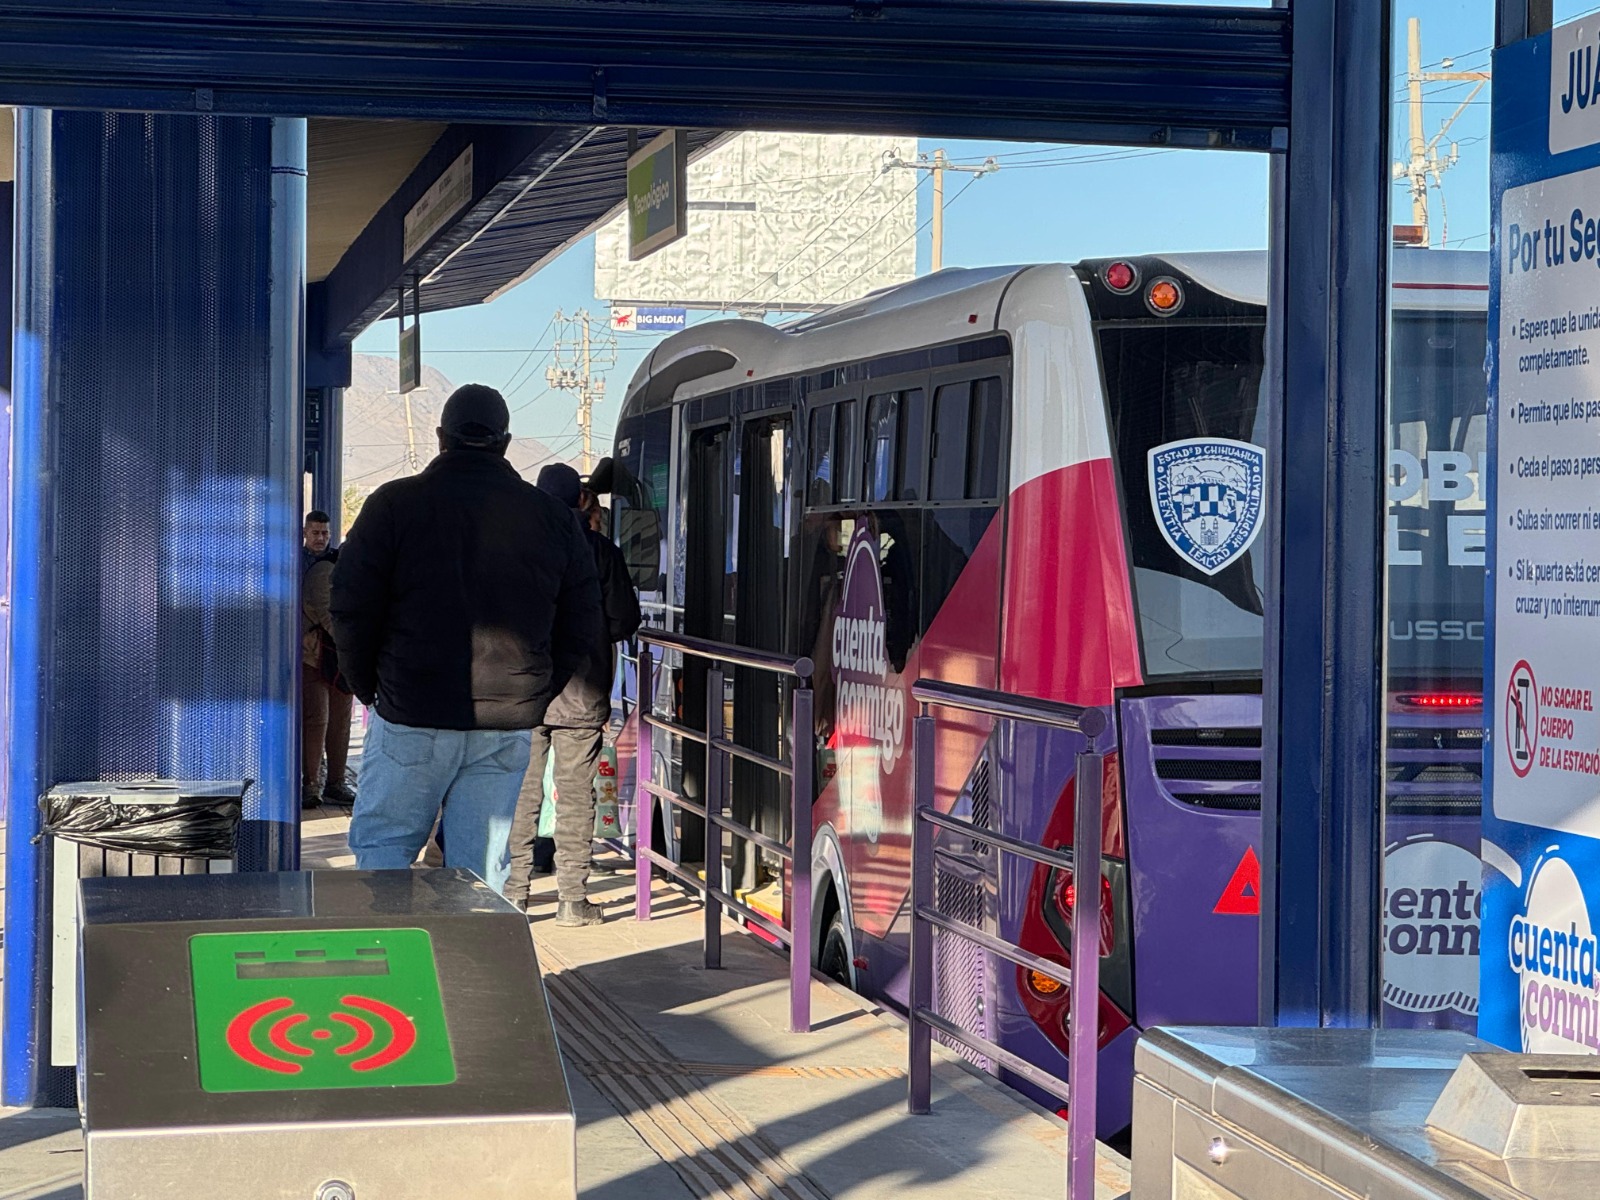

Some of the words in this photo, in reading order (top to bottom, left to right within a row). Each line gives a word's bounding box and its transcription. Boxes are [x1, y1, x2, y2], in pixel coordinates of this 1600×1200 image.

[633, 178, 669, 217] Tecnológico
[1509, 222, 1541, 274] Por
[1544, 219, 1565, 268] tu
[1569, 208, 1600, 269] Se
[637, 315, 653, 324] BIG
[654, 315, 684, 324] MEDIA
[1519, 318, 1549, 343] Espere
[1550, 317, 1567, 340] que
[1568, 311, 1576, 333] la
[1519, 344, 1590, 375] completamente.
[1518, 399, 1551, 424] Permita
[1552, 404, 1570, 426] que
[1571, 397, 1584, 420] los
[1203, 446, 1260, 465] CHIHUAHUA
[1517, 455, 1540, 478] Ceda
[1541, 455, 1550, 476] el
[1550, 458, 1572, 481] paso
[1573, 459, 1579, 476] a
[1580, 457, 1600, 480] pers
[1388, 449, 1487, 501] OB
[1155, 474, 1182, 542] VALENTIA
[1516, 509, 1539, 530] Suba
[1540, 507, 1553, 530] sin
[1554, 512, 1582, 530] correr
[1582, 506, 1591, 530] ni
[1187, 544, 1231, 568] LEALTAD
[1516, 559, 1525, 581] Si
[1535, 561, 1563, 586] puerta
[1565, 559, 1585, 582] está
[1515, 596, 1543, 614] cruzar
[1543, 598, 1550, 619] y
[1551, 598, 1562, 616] no
[1540, 686, 1552, 707] NO
[1553, 687, 1582, 710] SACAR
[1583, 690, 1593, 712] EL
[840, 680, 904, 761] conmigo
[1540, 716, 1574, 741] CUERPO
[1540, 746, 1550, 768] DE
[1551, 748, 1562, 770] LA
[1563, 748, 1600, 777] ESTACIÓ
[1384, 881, 1481, 920] ent
[1525, 979, 1600, 1050] conmi
